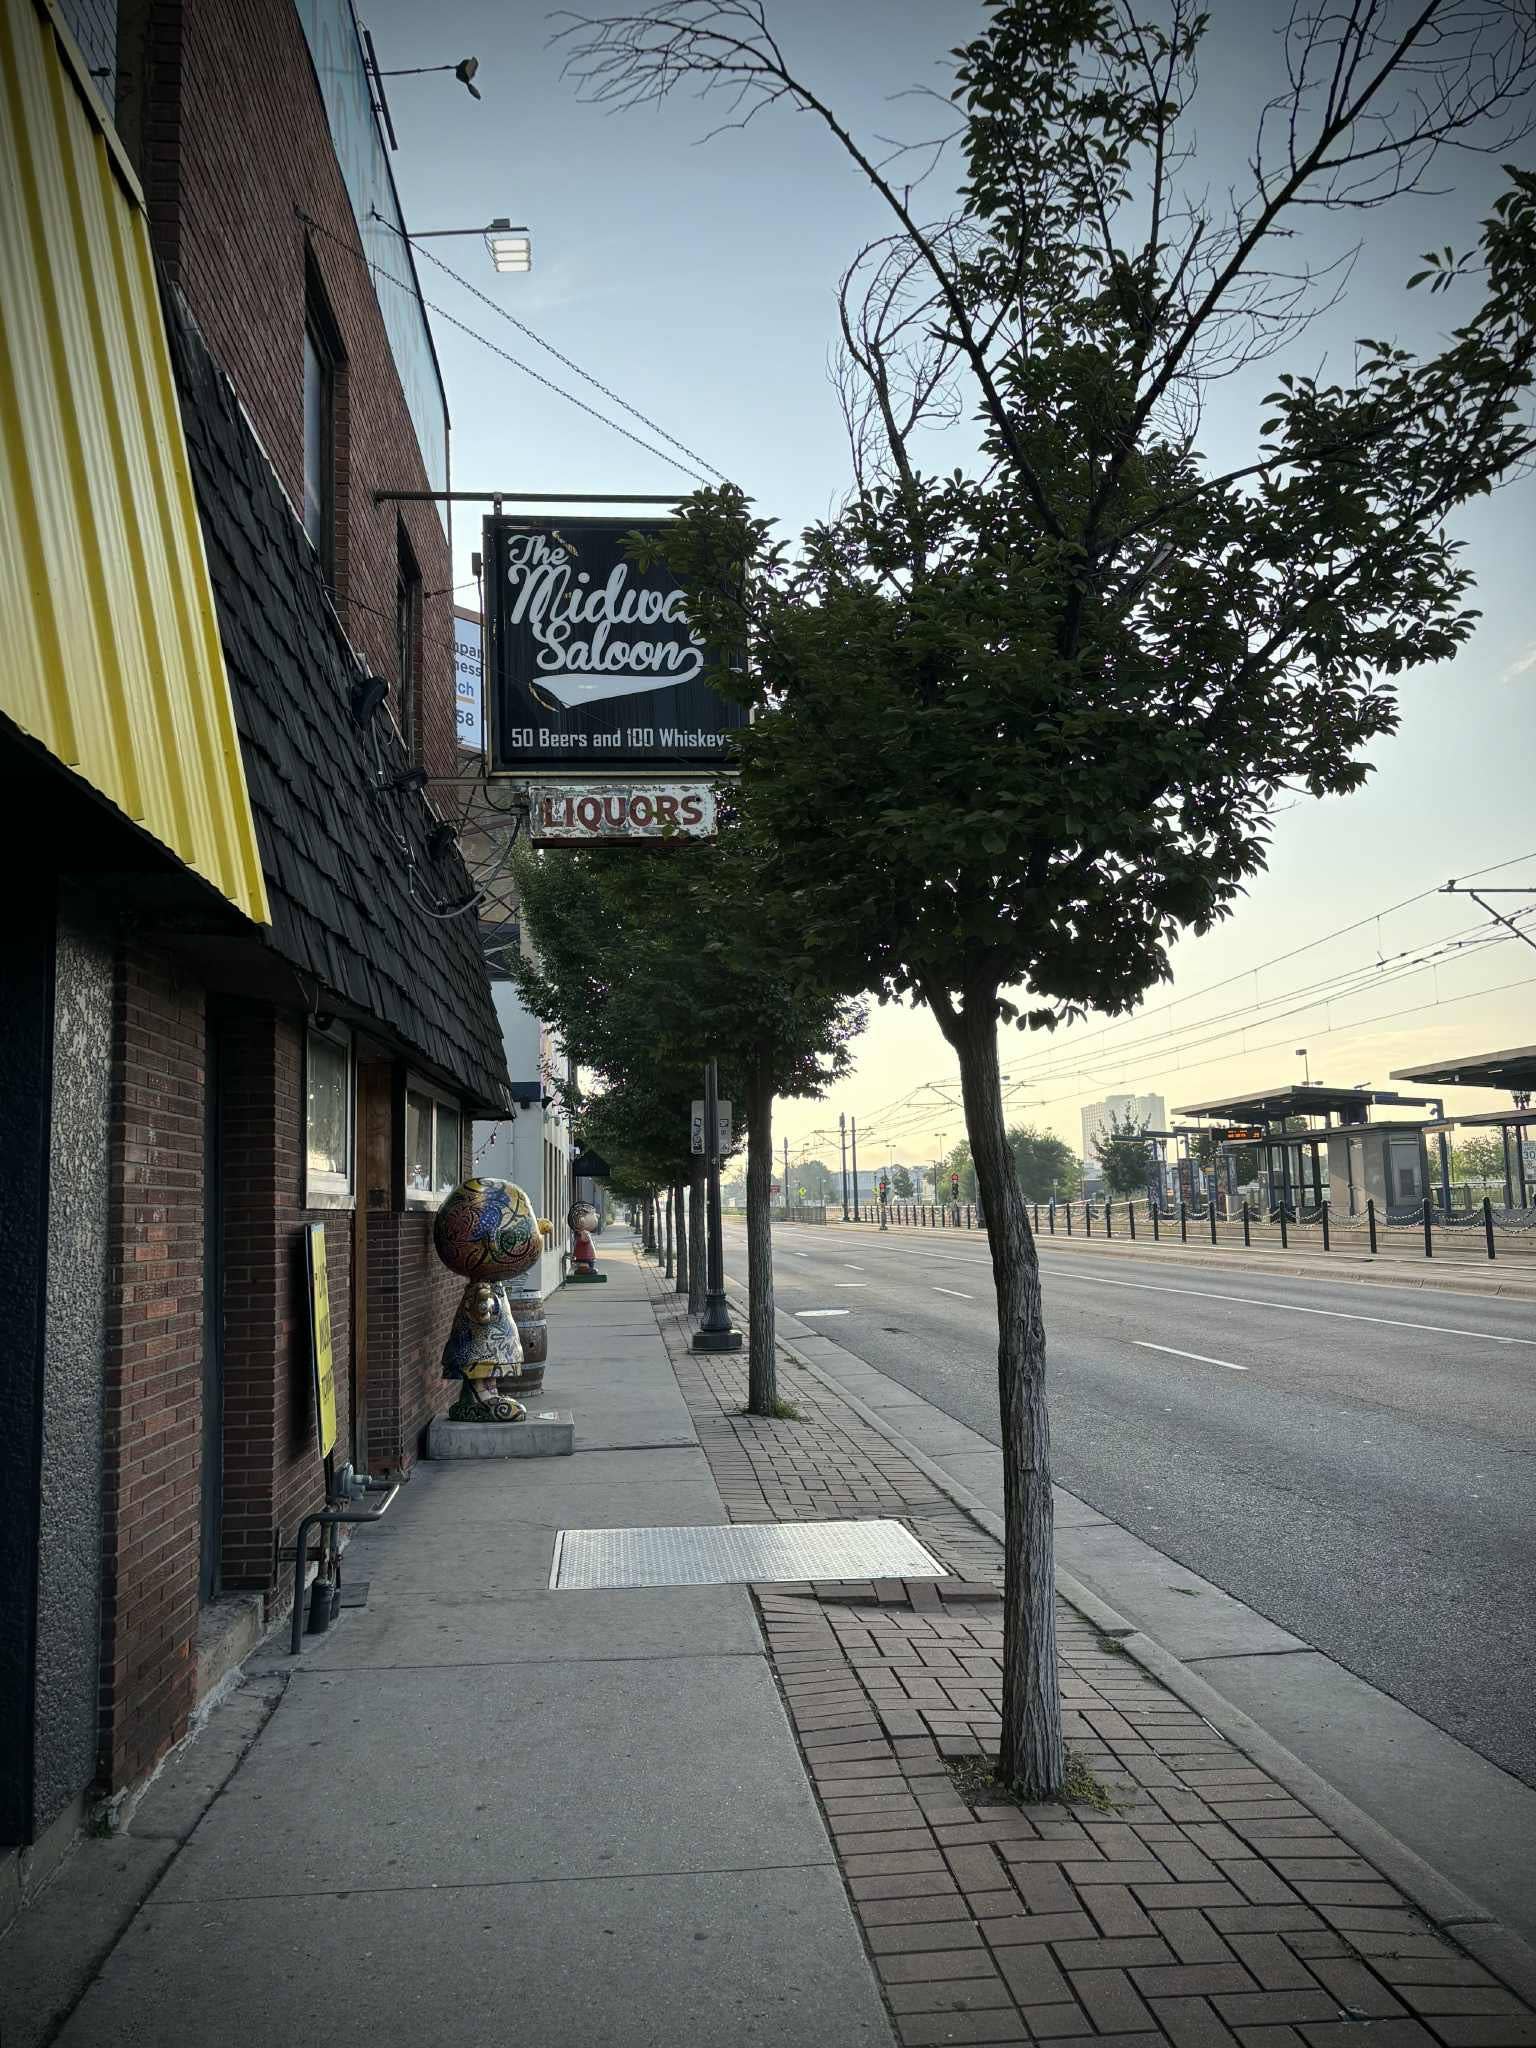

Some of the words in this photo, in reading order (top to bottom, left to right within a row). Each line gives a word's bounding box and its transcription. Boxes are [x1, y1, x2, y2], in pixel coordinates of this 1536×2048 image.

[508, 534, 569, 565] The
[508, 563, 702, 640] Midwa
[532, 620, 680, 671] Saloon
[511, 728, 533, 747] 50
[539, 728, 587, 747] Beers
[593, 728, 621, 747] and
[627, 728, 654, 747] 100
[542, 795, 704, 832] LIQUORS
